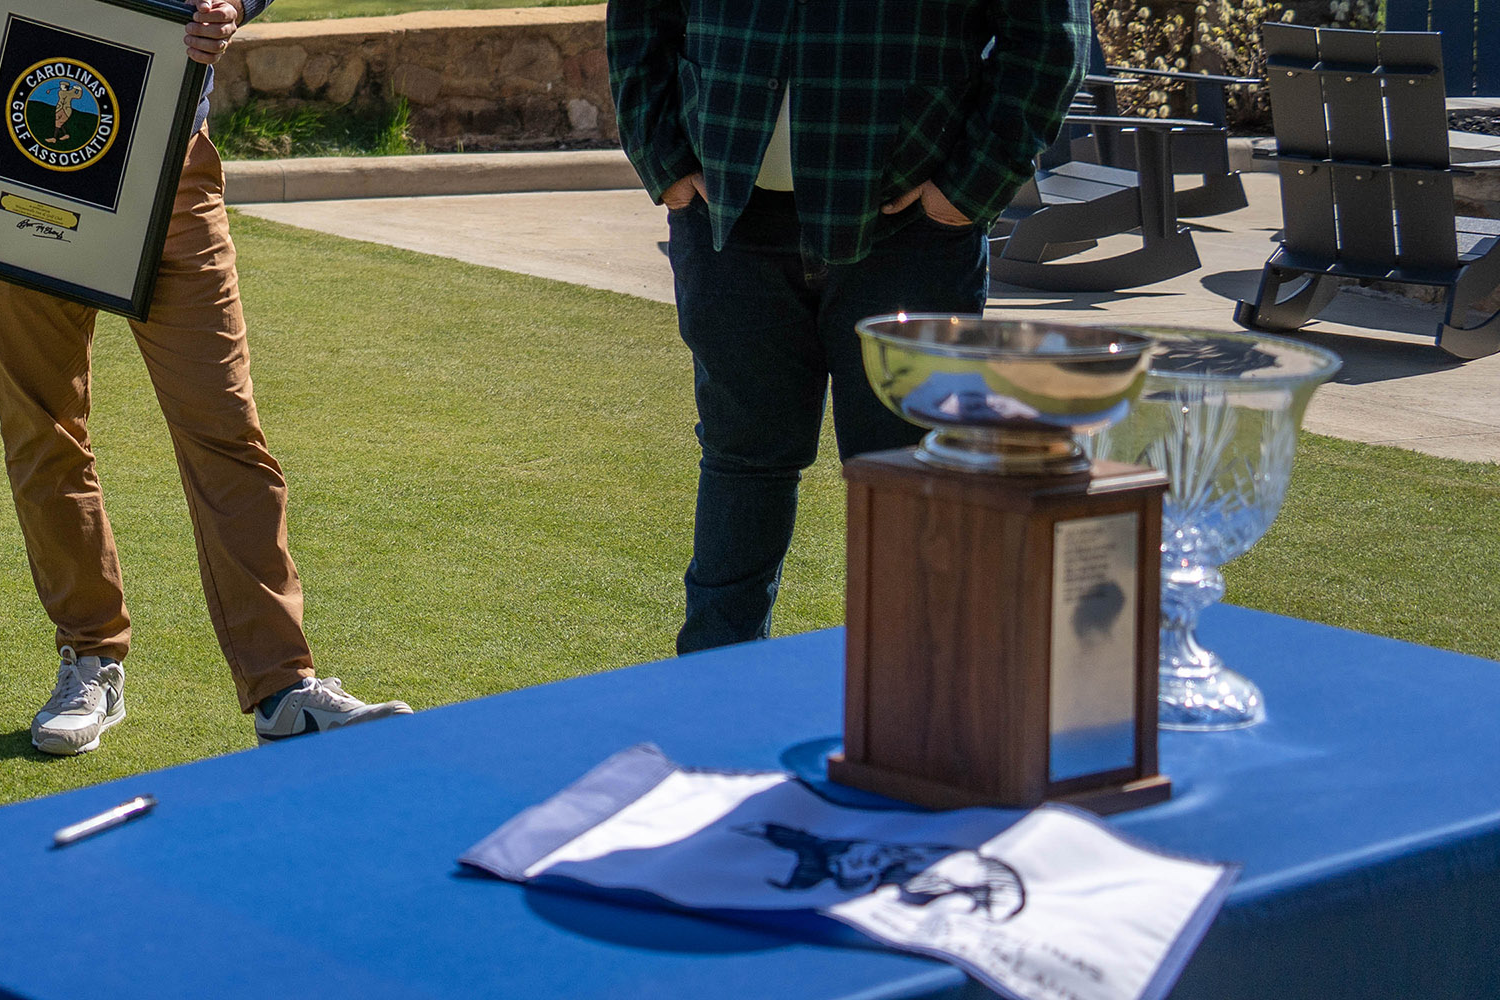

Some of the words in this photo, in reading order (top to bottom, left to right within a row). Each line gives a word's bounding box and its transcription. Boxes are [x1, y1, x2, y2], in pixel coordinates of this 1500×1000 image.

[25, 62, 106, 99] CAROLINAS
[11, 101, 31, 142] GOLF
[28, 113, 114, 166] ASSOCIATION
